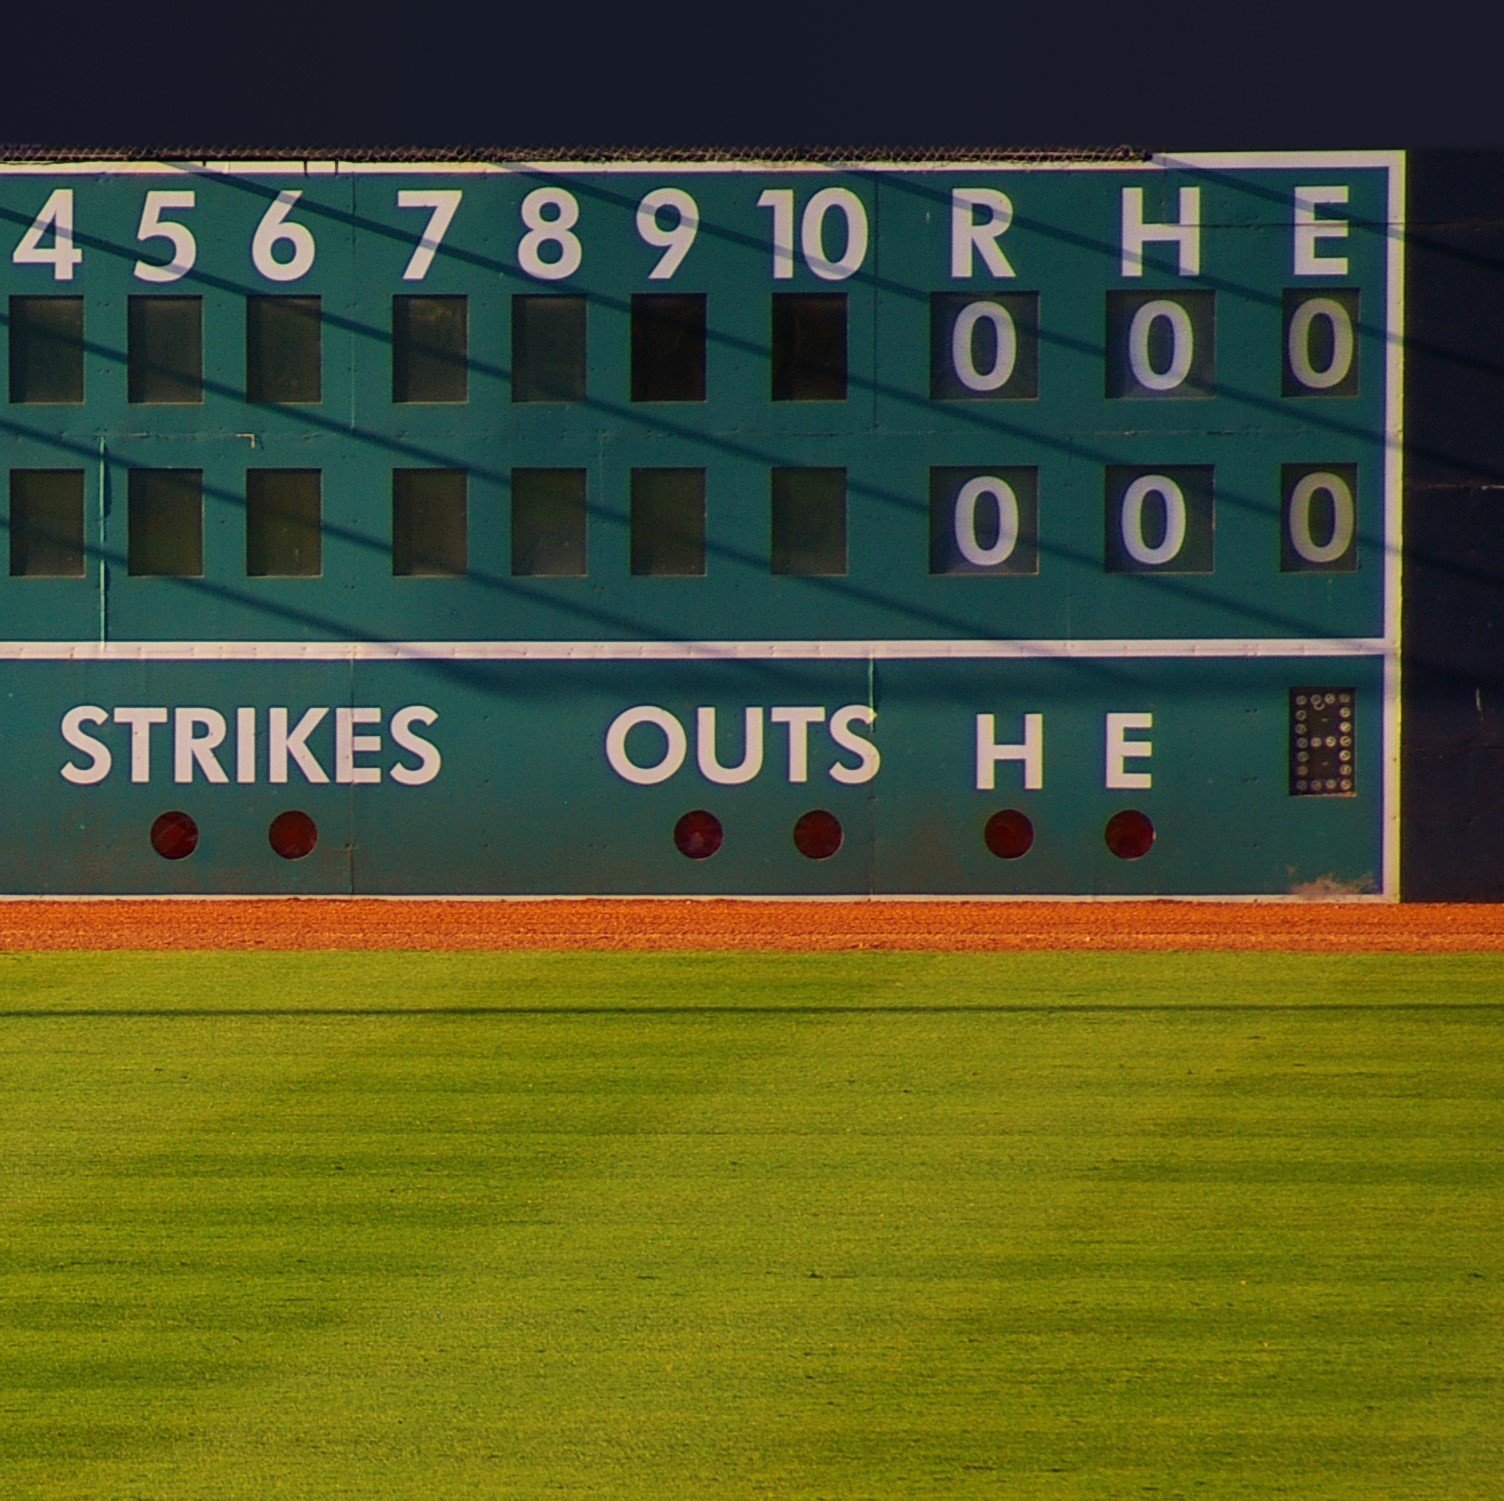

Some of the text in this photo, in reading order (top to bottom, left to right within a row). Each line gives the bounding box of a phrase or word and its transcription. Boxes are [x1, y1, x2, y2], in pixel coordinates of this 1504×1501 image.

[11, 188, 84, 281] 4
[132, 189, 198, 283] 5
[250, 189, 316, 283] 6
[396, 189, 464, 281] 7
[517, 186, 583, 281] 8
[635, 187, 700, 280] 9
[756, 188, 869, 280] 10
[950, 185, 1350, 279] R H E
[952, 296, 1354, 392] 0 0 0
[953, 471, 1355, 566] 0 0 0
[59, 705, 443, 786] STRIKES
[605, 704, 883, 786] OUTS
[975, 712, 1044, 791] H
[1104, 711, 1154, 790] E
